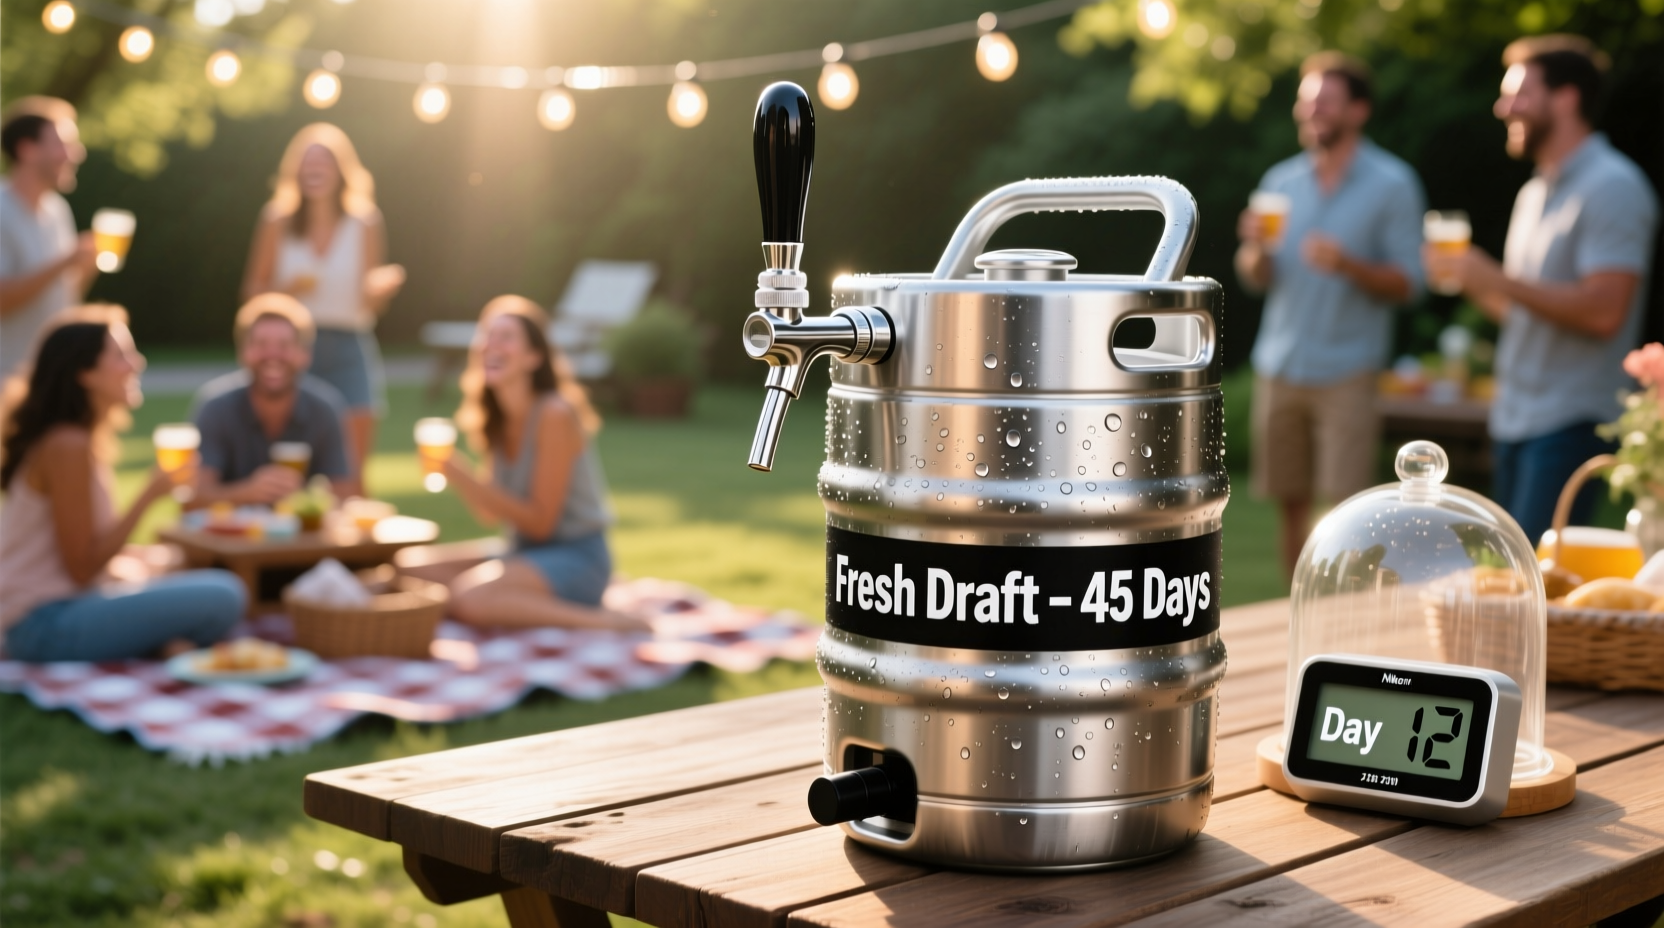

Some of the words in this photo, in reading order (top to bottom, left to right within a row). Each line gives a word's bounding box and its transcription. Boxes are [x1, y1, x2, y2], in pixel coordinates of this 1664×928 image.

[835, 553, 916, 618] Fresh
[926, 566, 1040, 625] Draft
[1080, 569, 1133, 624] 45
[1142, 567, 1211, 627] Days
[1320, 706, 1383, 756] Day
[1406, 705, 1464, 770] 12
